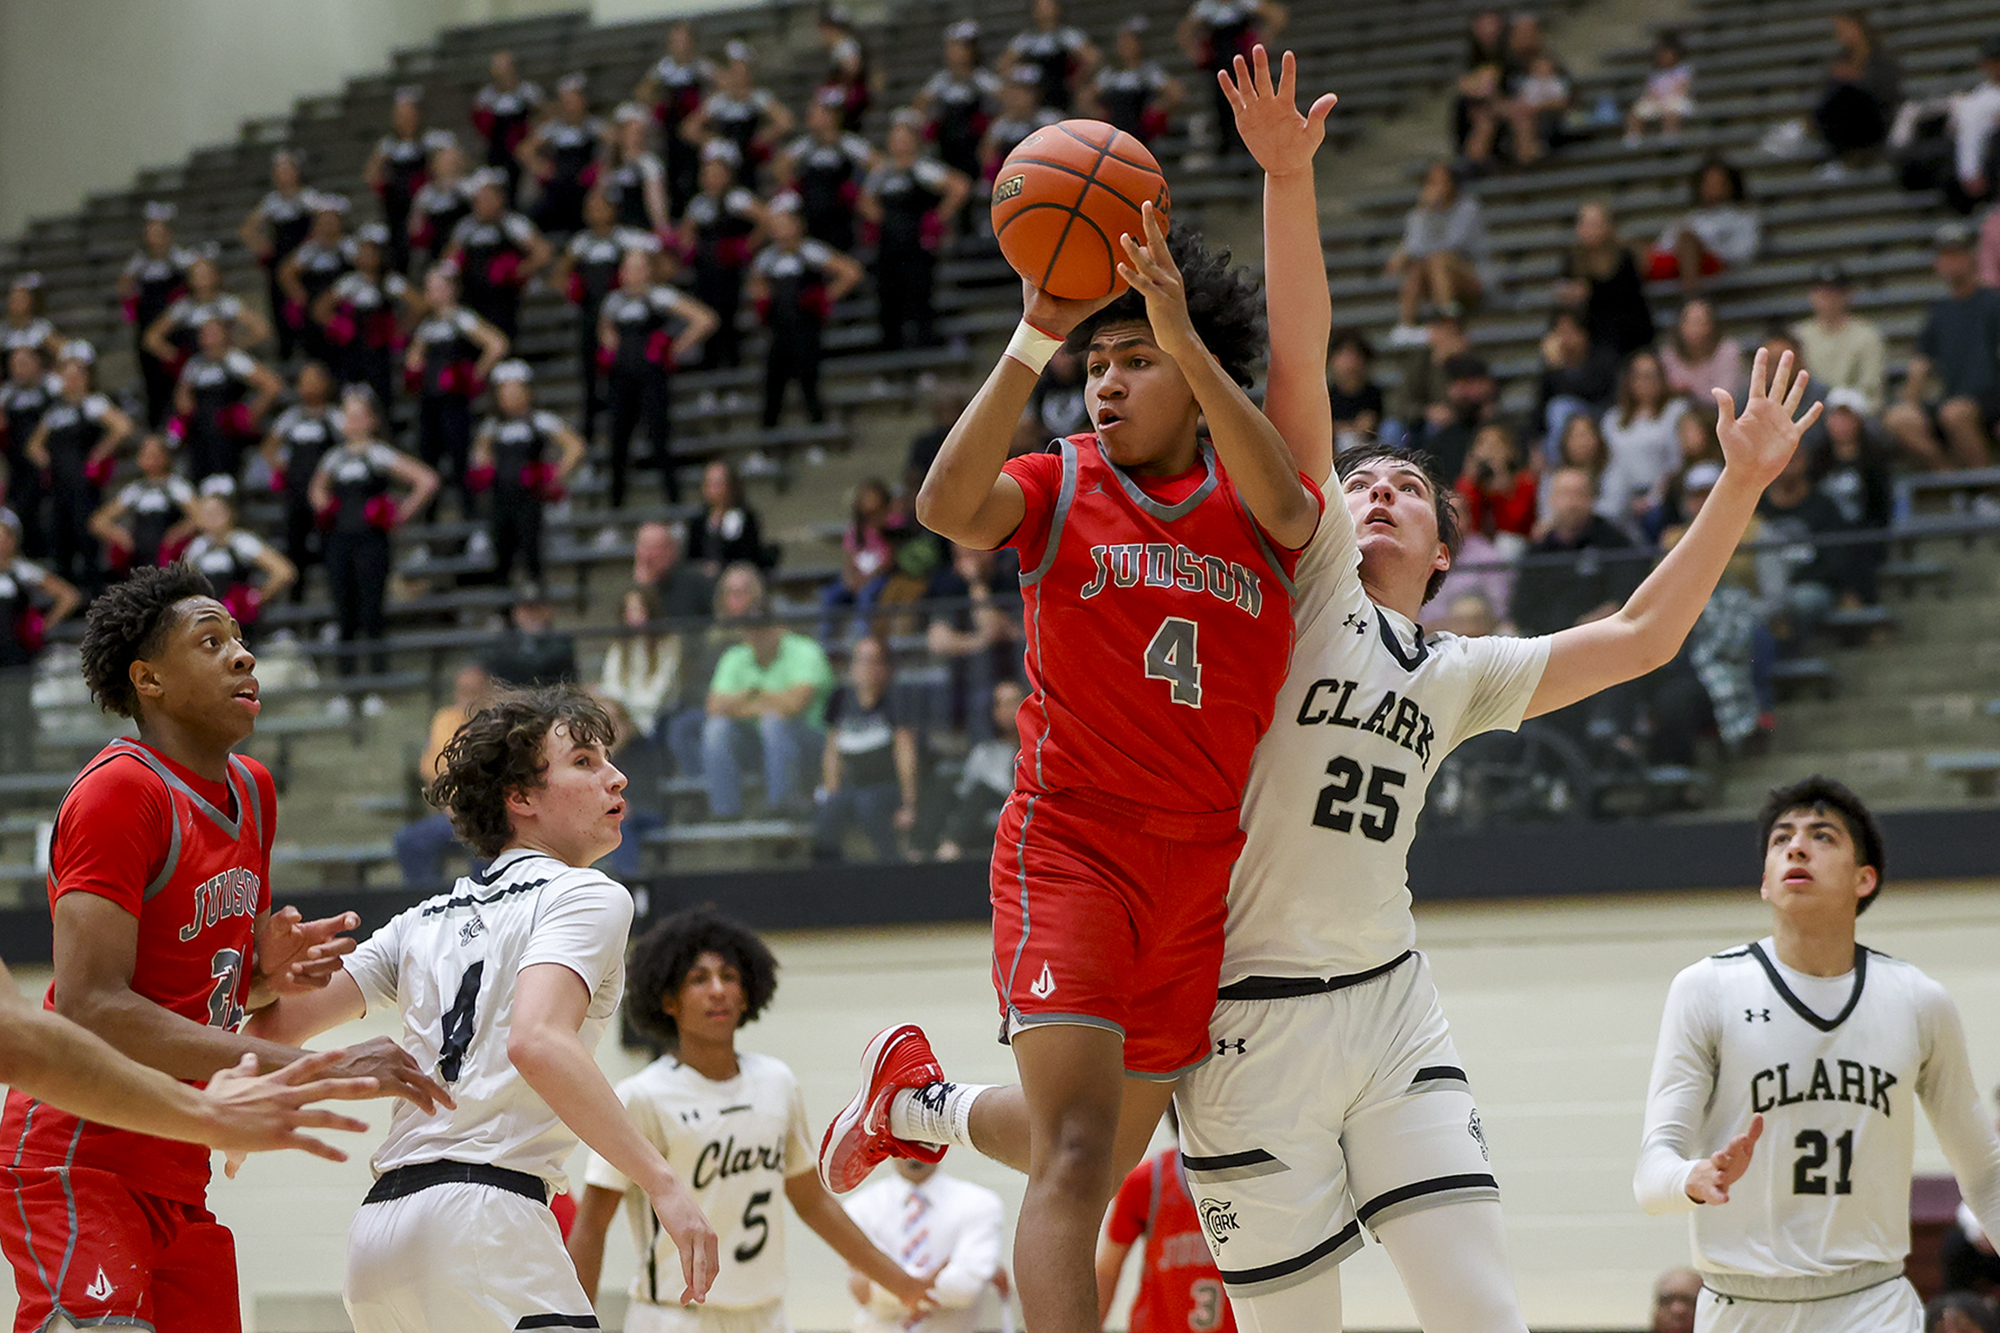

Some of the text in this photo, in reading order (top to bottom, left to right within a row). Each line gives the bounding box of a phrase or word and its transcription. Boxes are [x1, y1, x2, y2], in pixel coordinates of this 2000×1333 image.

[1080, 543, 1262, 618] JUDSON
[1144, 616, 1202, 709] 4
[1296, 678, 1434, 773] CLARK
[1311, 755, 1406, 842] 25
[179, 866, 261, 942] JUDSO
[1752, 1058, 1898, 1118] CLARK
[1793, 1129, 1853, 1195] 21
[734, 1190, 773, 1263] 5
